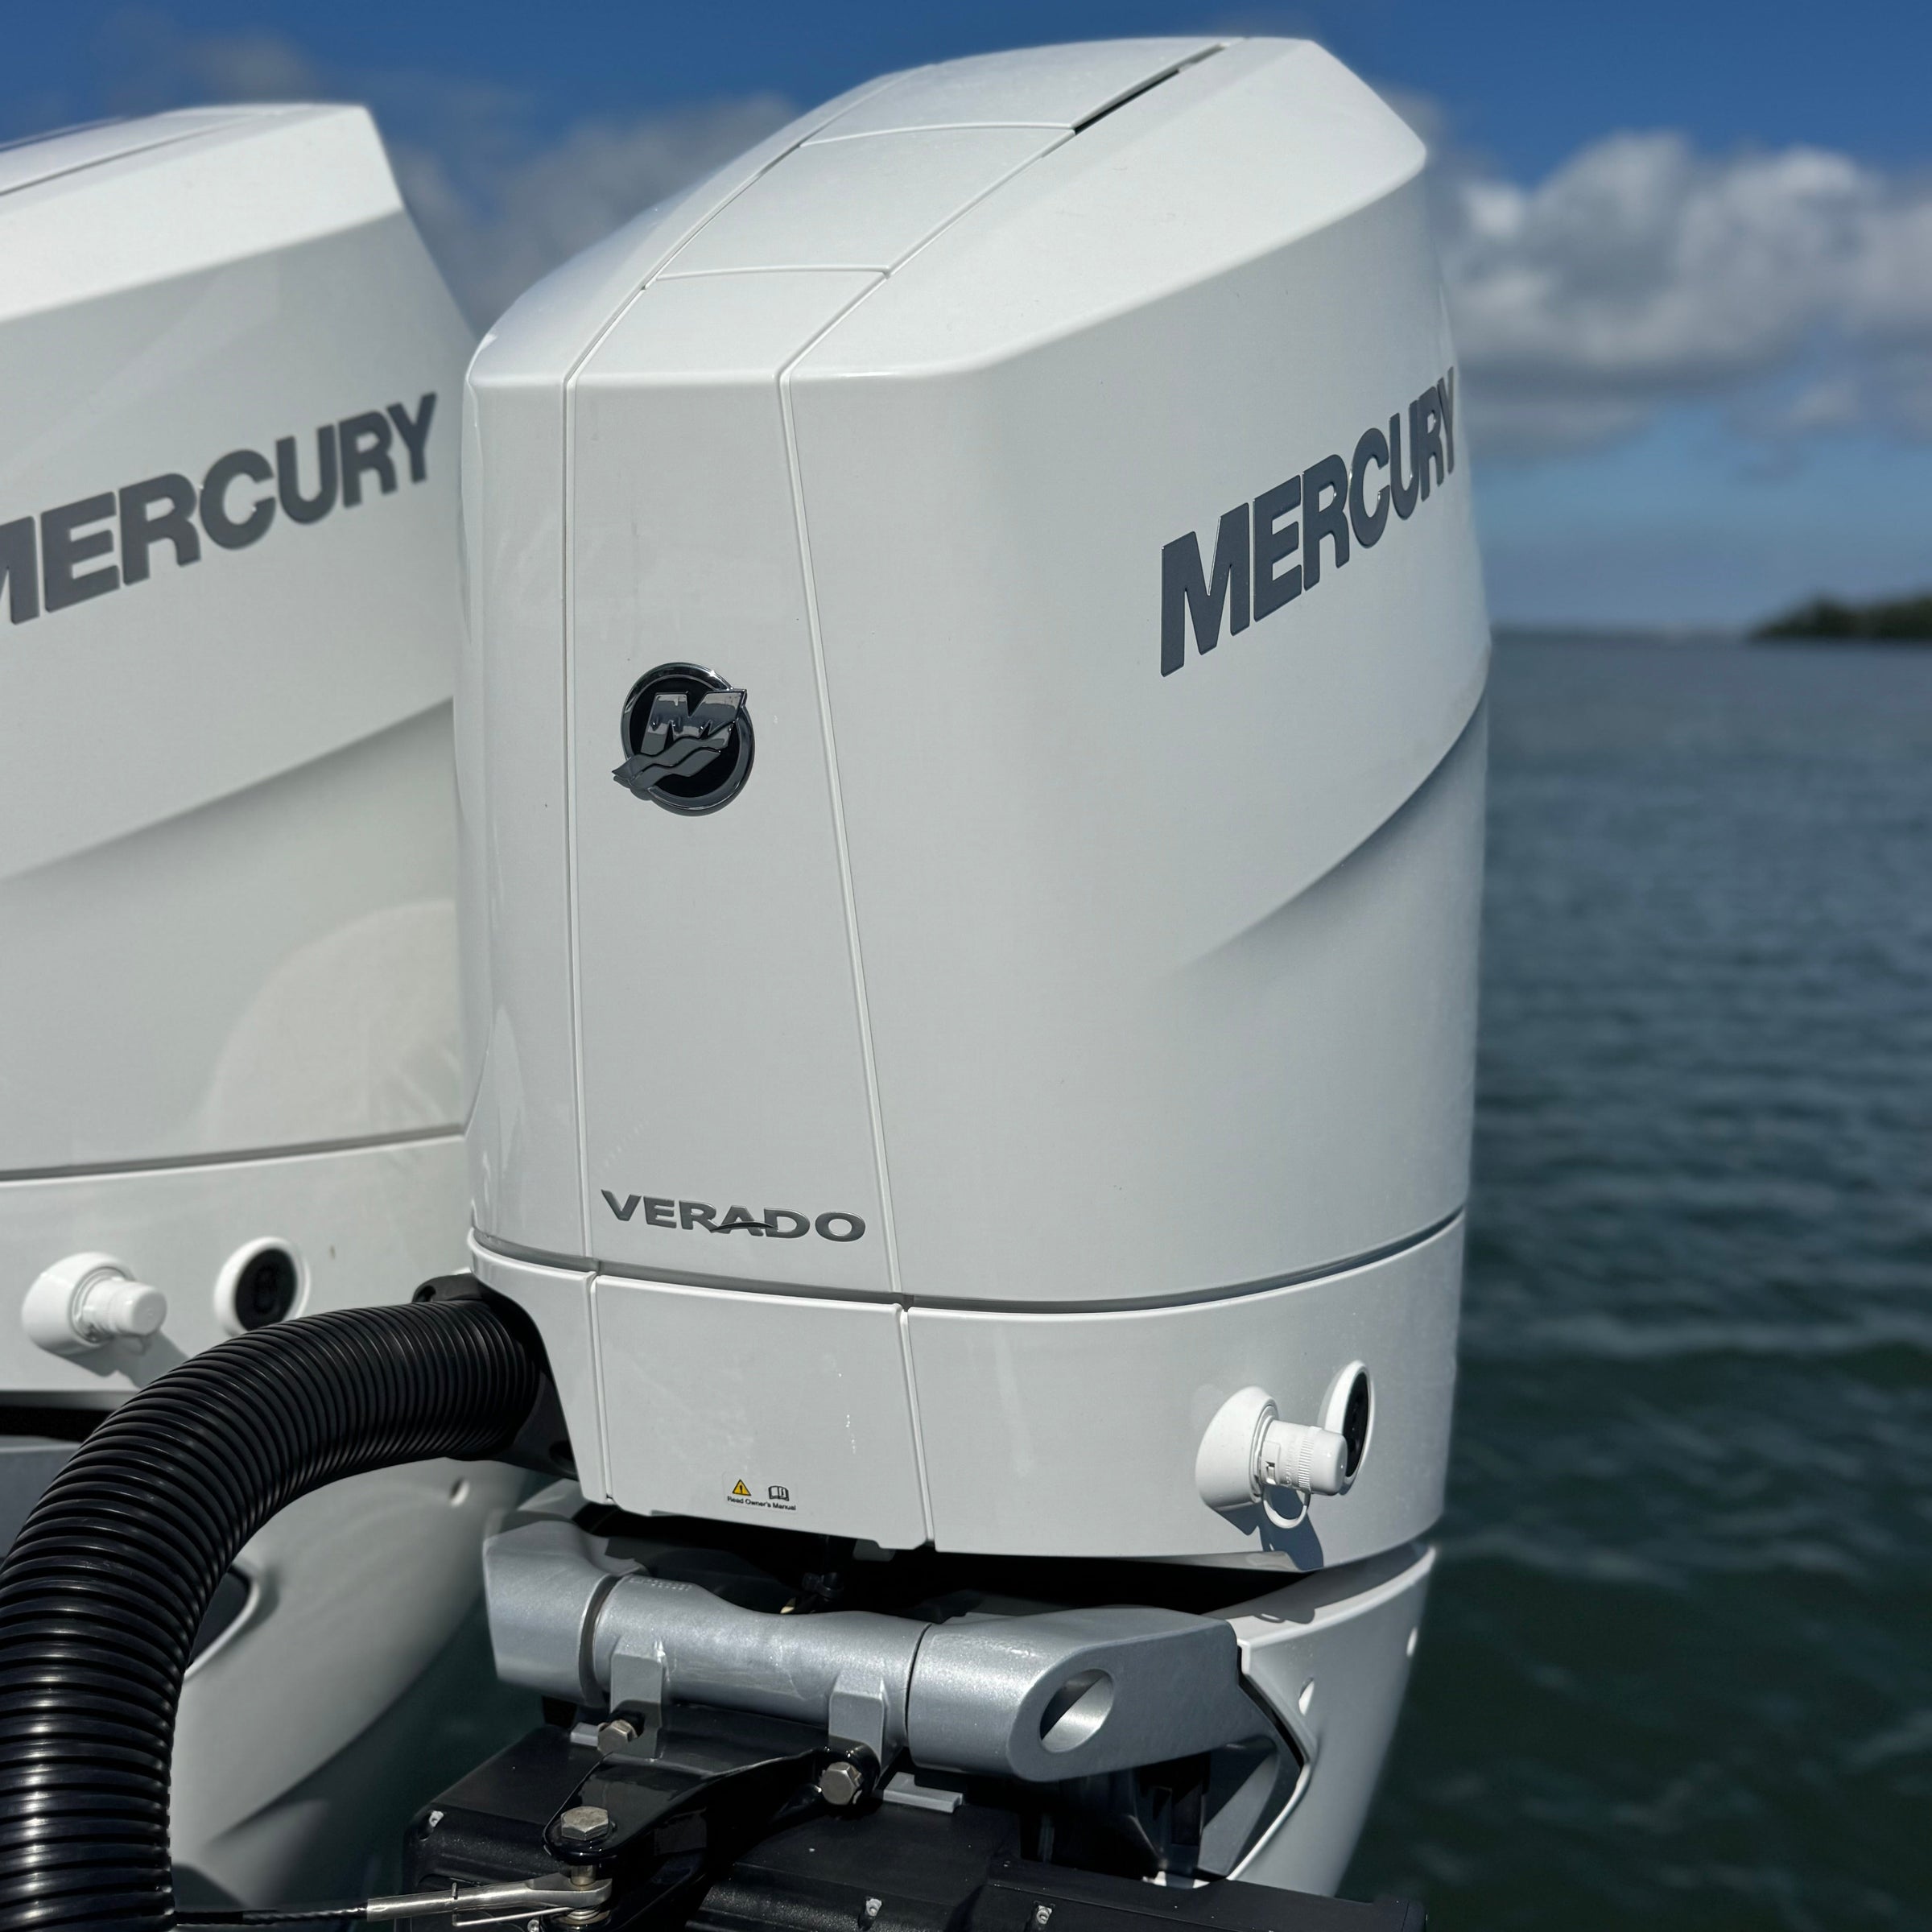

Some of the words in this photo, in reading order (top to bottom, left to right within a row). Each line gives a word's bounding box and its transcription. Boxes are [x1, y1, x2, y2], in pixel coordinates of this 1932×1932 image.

[1161, 366, 1455, 677] MERCURY
[601, 1189, 866, 1242] VERADO
[727, 1496, 744, 1504] Read
[745, 1498, 771, 1508] Owner's
[772, 1502, 796, 1511] Manual
